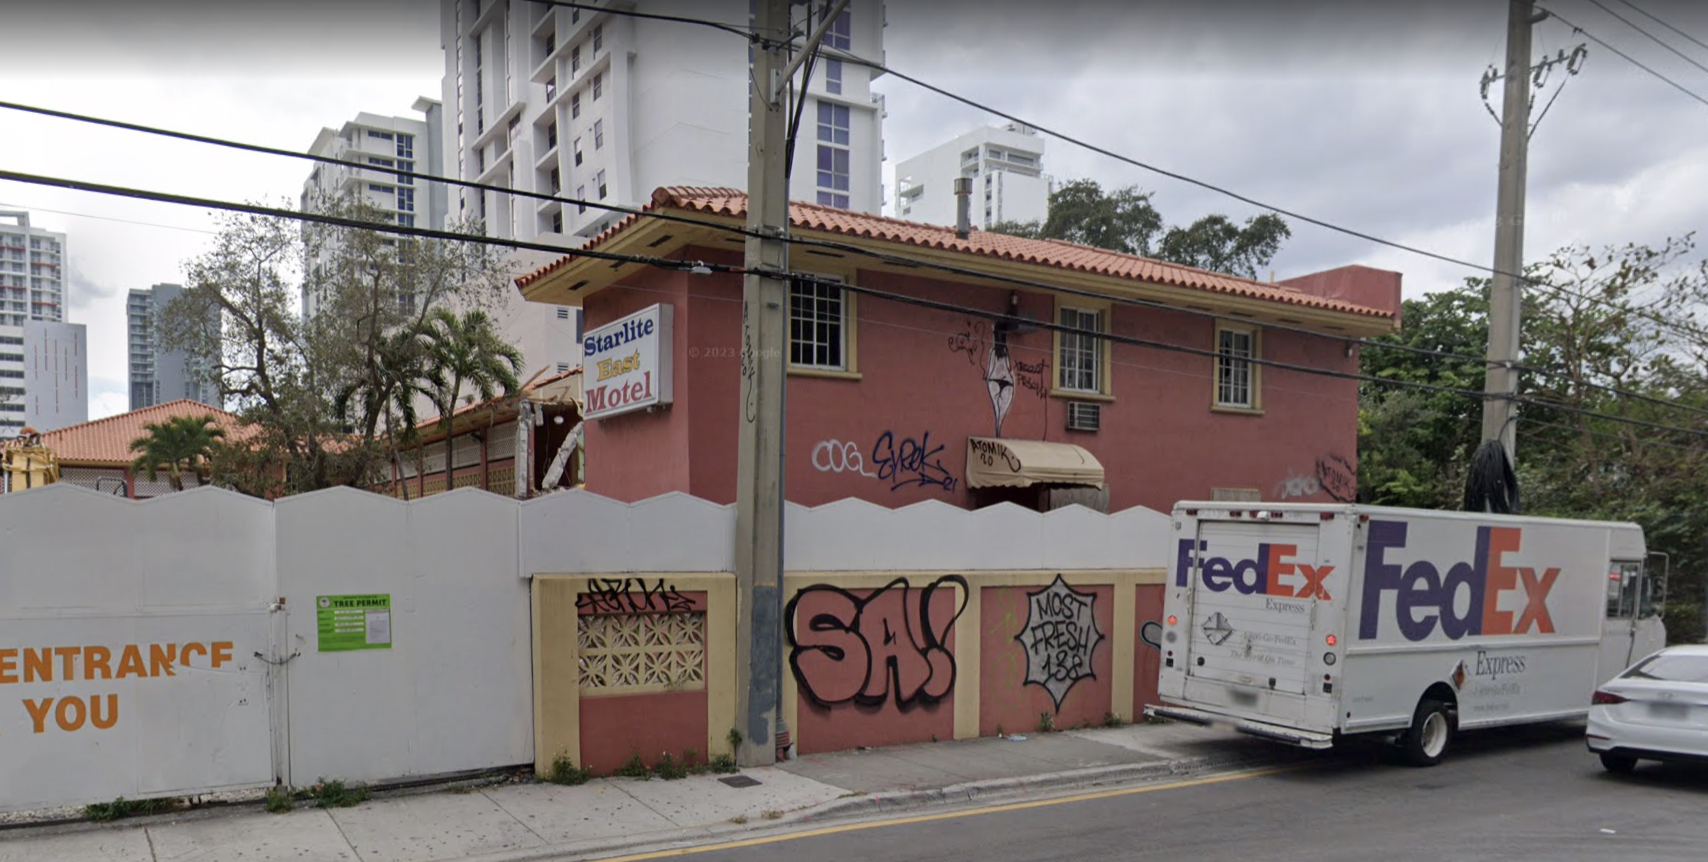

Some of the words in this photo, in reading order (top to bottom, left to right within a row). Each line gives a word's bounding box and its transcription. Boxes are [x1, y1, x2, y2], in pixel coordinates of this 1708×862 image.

[584, 318, 654, 357] Starlite
[596, 347, 641, 382] East
[585, 371, 653, 414] Motel
[970, 438, 1021, 473] ATOMIK
[980, 453, 994, 467] 20
[1176, 538, 1336, 601] FedEx
[1359, 519, 1562, 642] FedEx
[334, 600, 354, 608] TREE
[357, 599, 387, 607] PERMIT
[1036, 591, 1088, 621] MOST
[1266, 598, 1305, 613] Express
[1030, 620, 1092, 656] FRESH
[1476, 651, 1526, 680] Express
[22, 693, 119, 734] YOU
